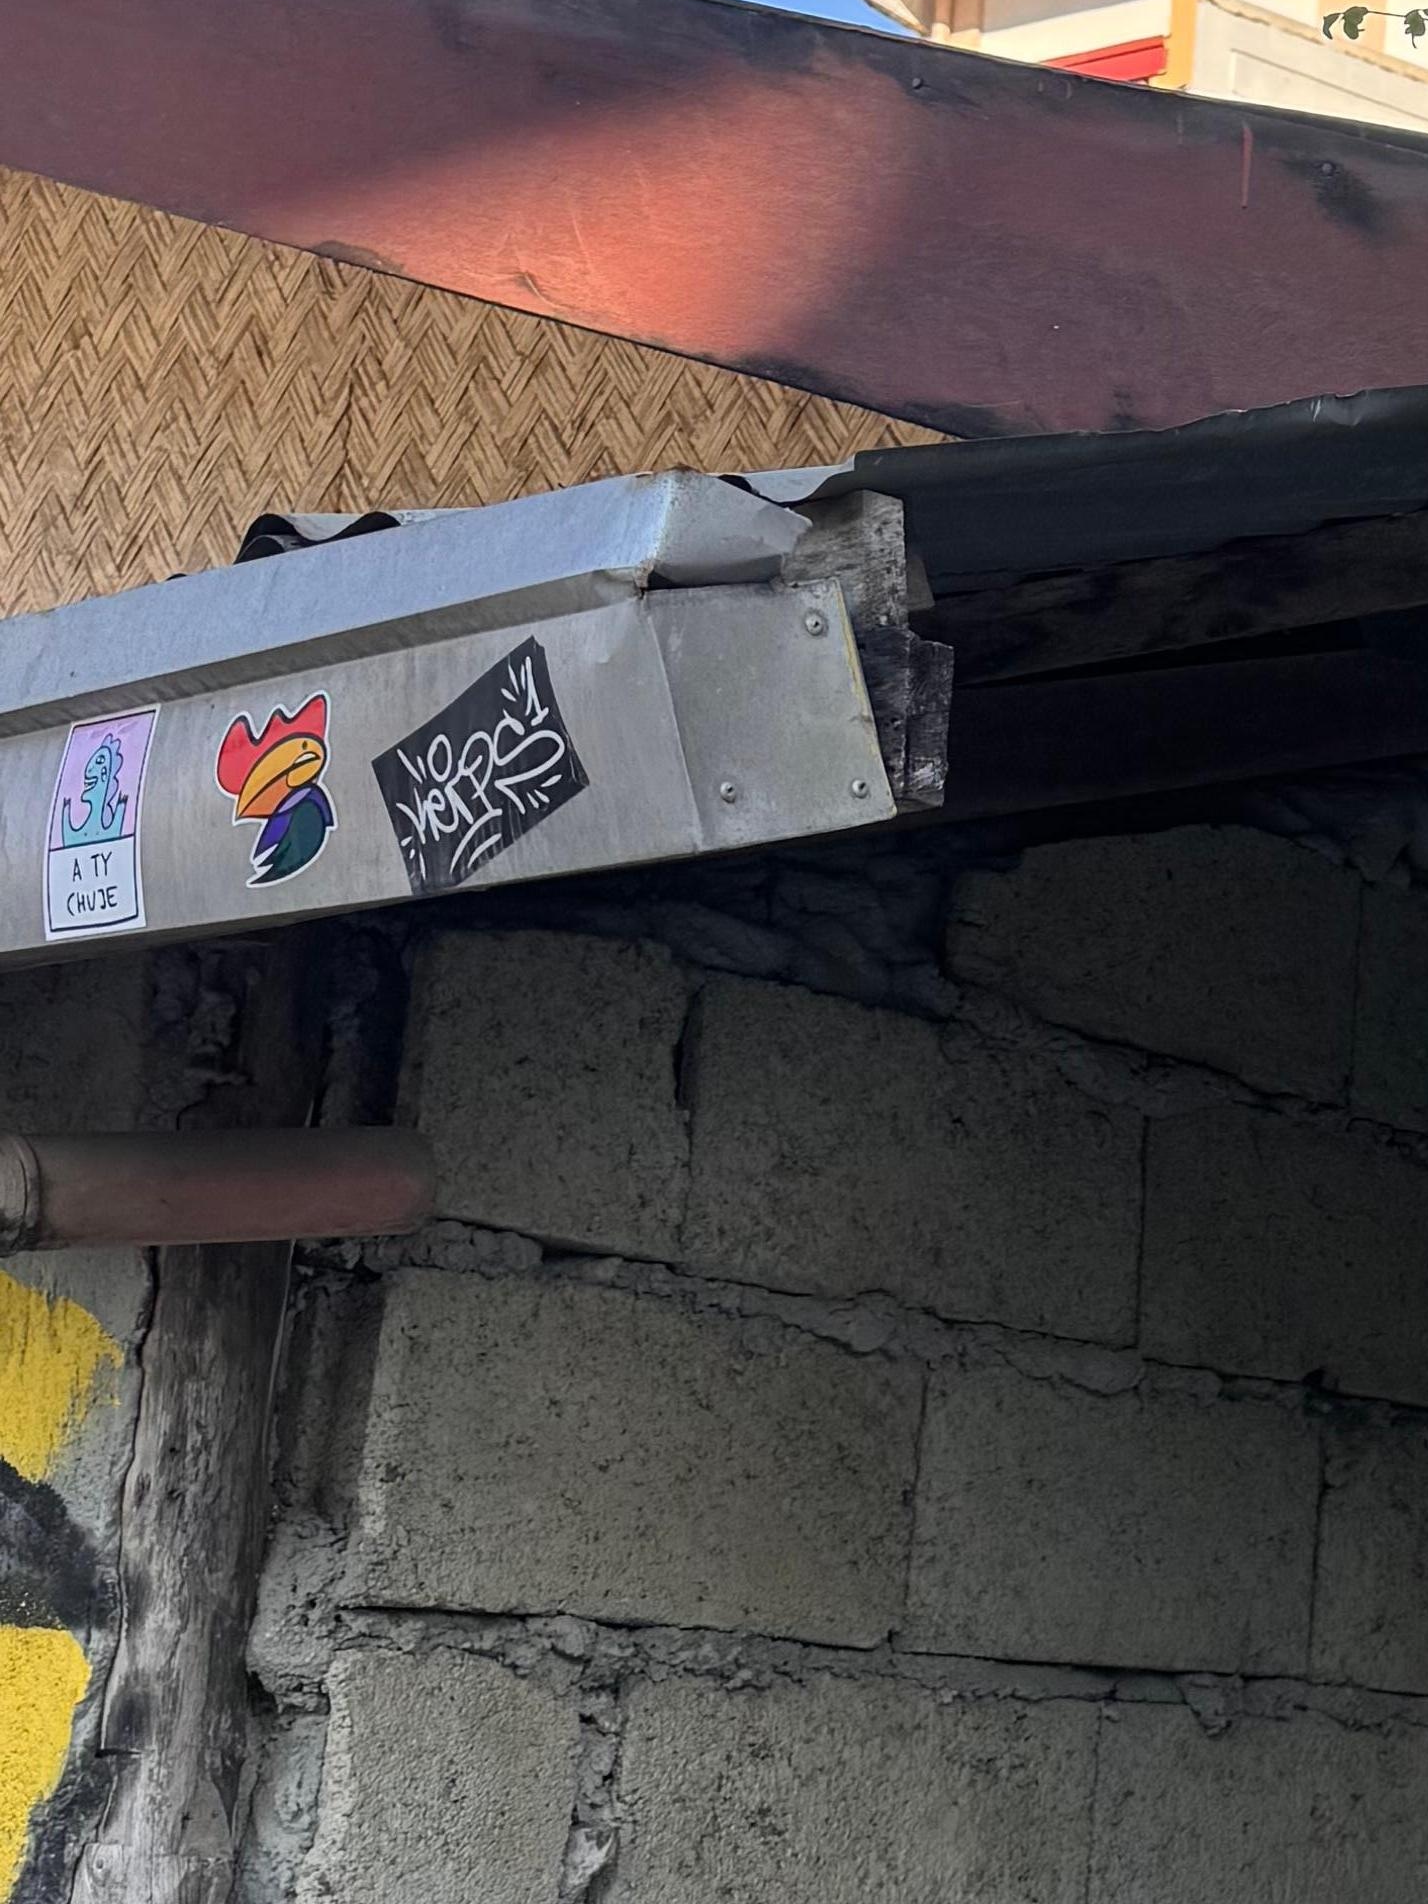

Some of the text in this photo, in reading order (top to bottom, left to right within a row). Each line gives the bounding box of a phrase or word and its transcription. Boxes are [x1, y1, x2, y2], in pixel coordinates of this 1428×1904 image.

[72, 851, 113, 882] A TY
[67, 885, 118, 916] CHUJE
